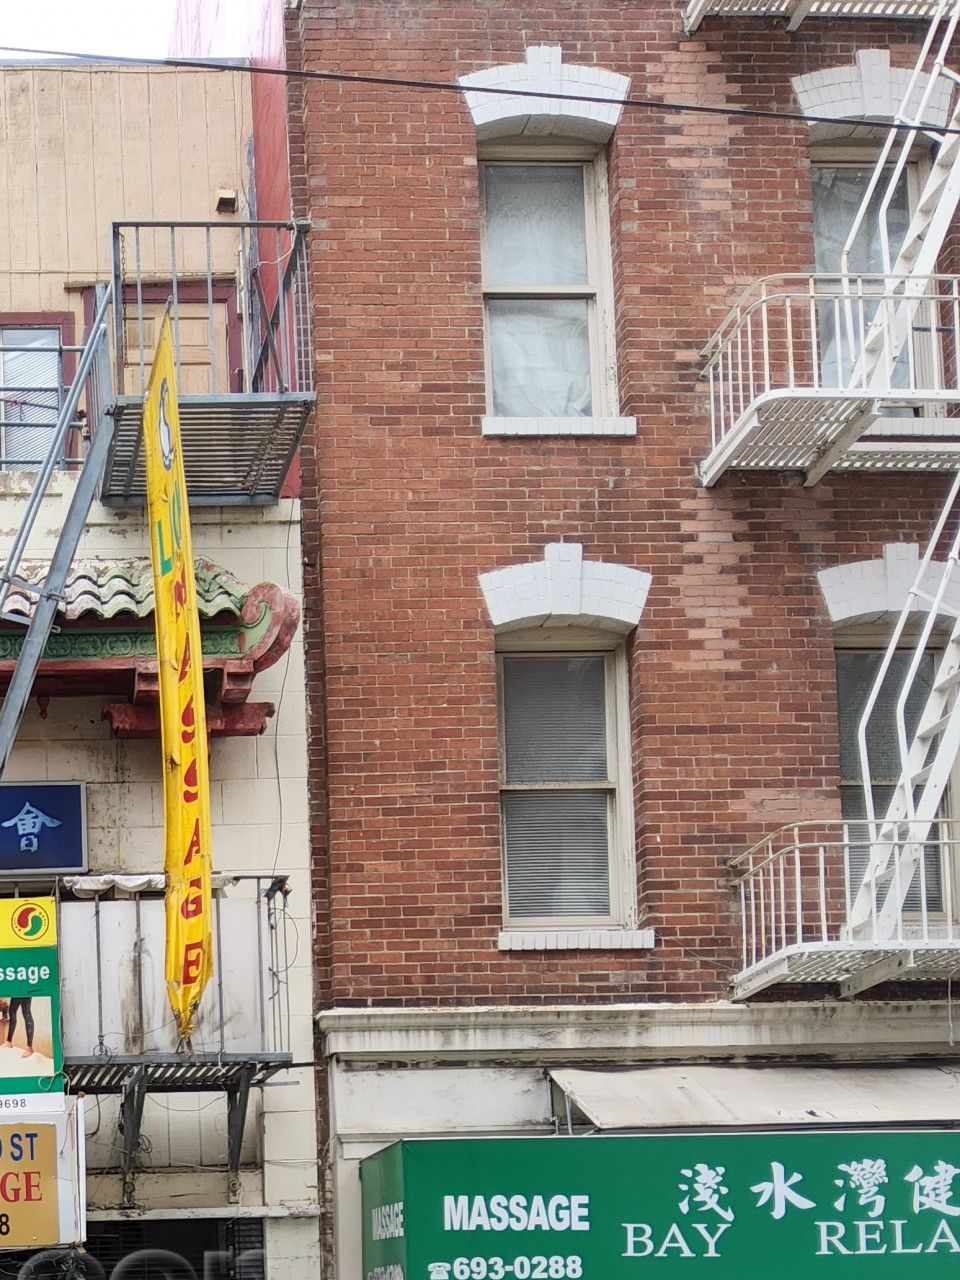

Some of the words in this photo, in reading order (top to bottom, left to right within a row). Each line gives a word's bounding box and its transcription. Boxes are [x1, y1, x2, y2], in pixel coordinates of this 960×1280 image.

[10, 1132, 40, 1161] ST
[372, 1201, 405, 1241] MASSAGE
[443, 1194, 590, 1232] MASSAGE
[621, 1222, 732, 1257] BAY
[814, 1219, 960, 1255] RELA
[452, 1255, 583, 1280] 693-0288
